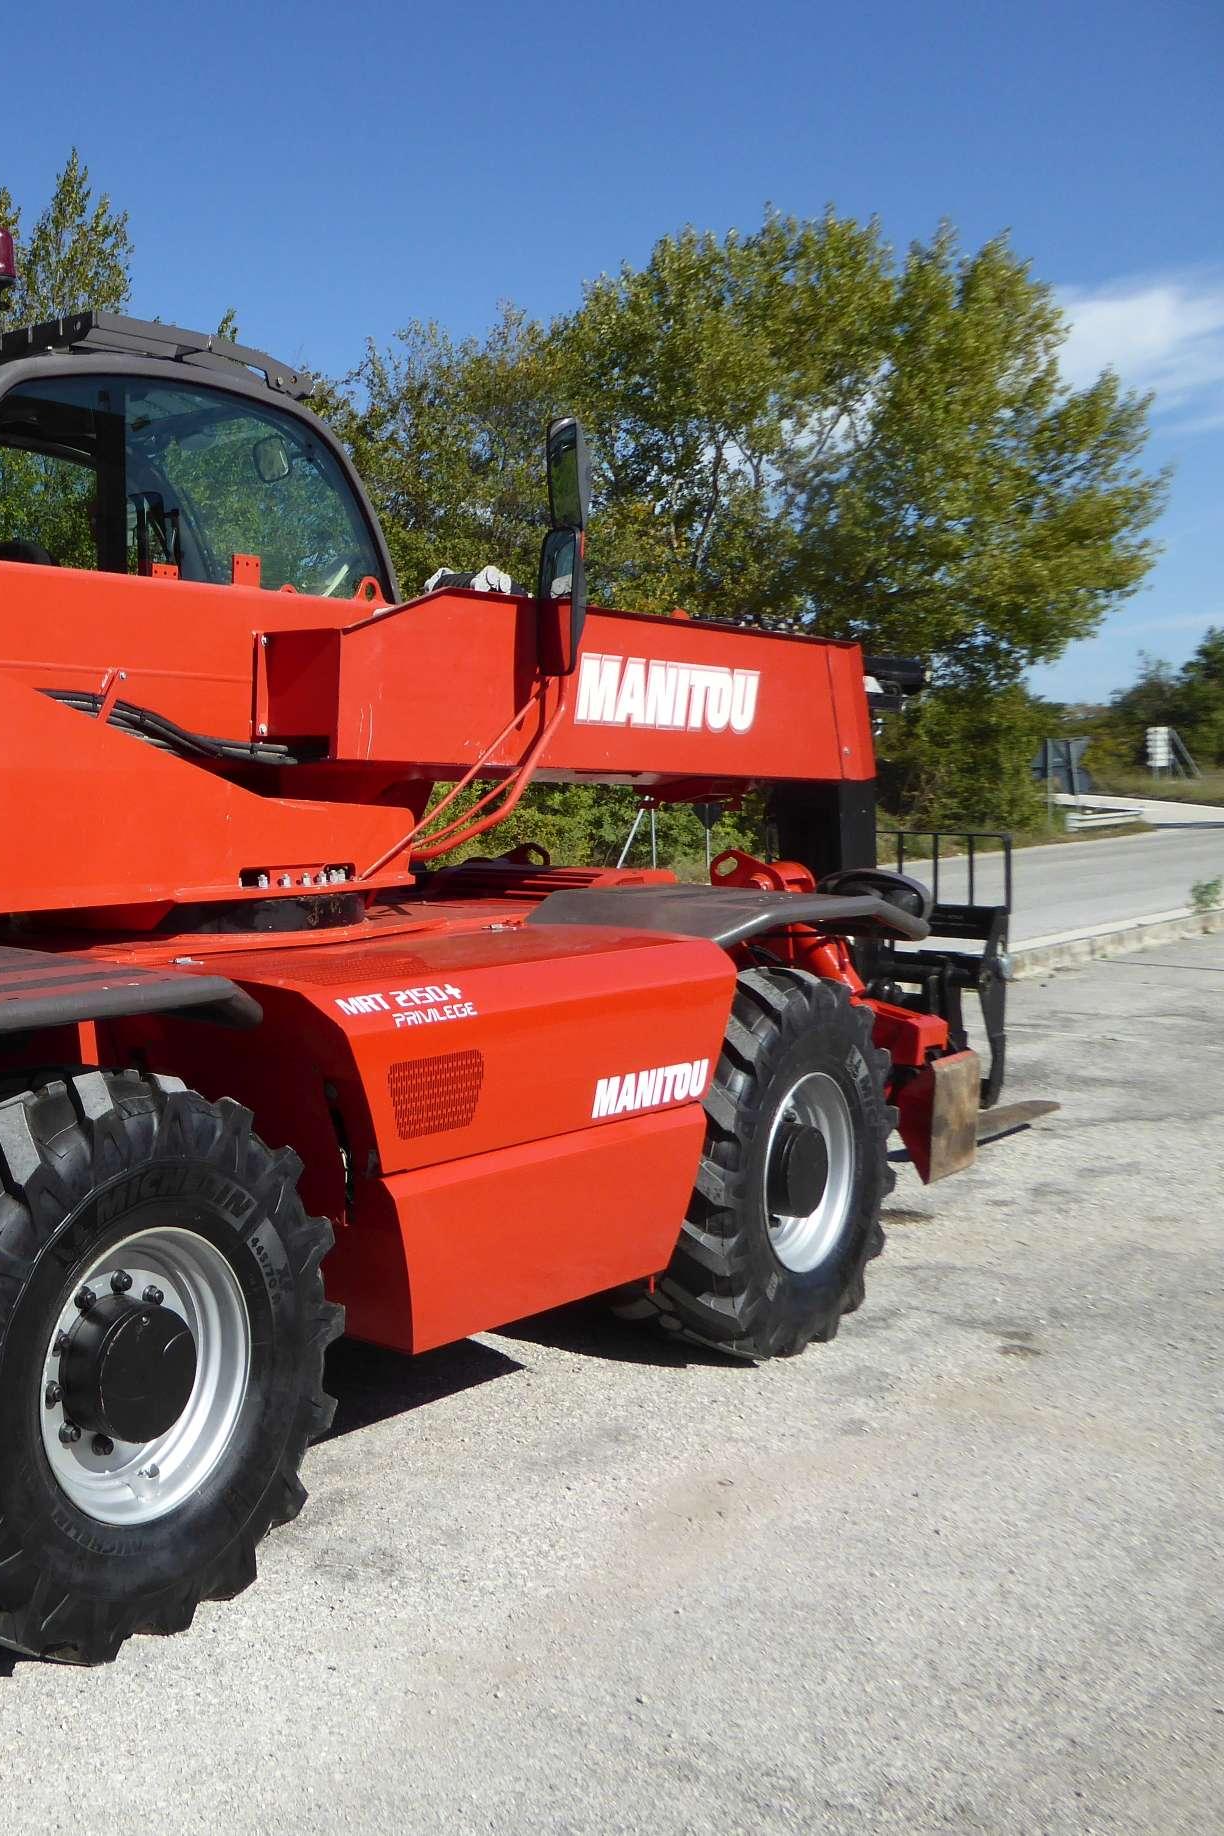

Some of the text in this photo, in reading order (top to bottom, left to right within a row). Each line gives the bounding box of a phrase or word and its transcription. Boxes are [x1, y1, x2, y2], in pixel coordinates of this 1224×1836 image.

[575, 653, 761, 734] MANITOU
[334, 983, 462, 1016] MRT 2150+
[392, 1002, 478, 1028] PRIVILEGE
[591, 1058, 710, 1119] MANITOU
